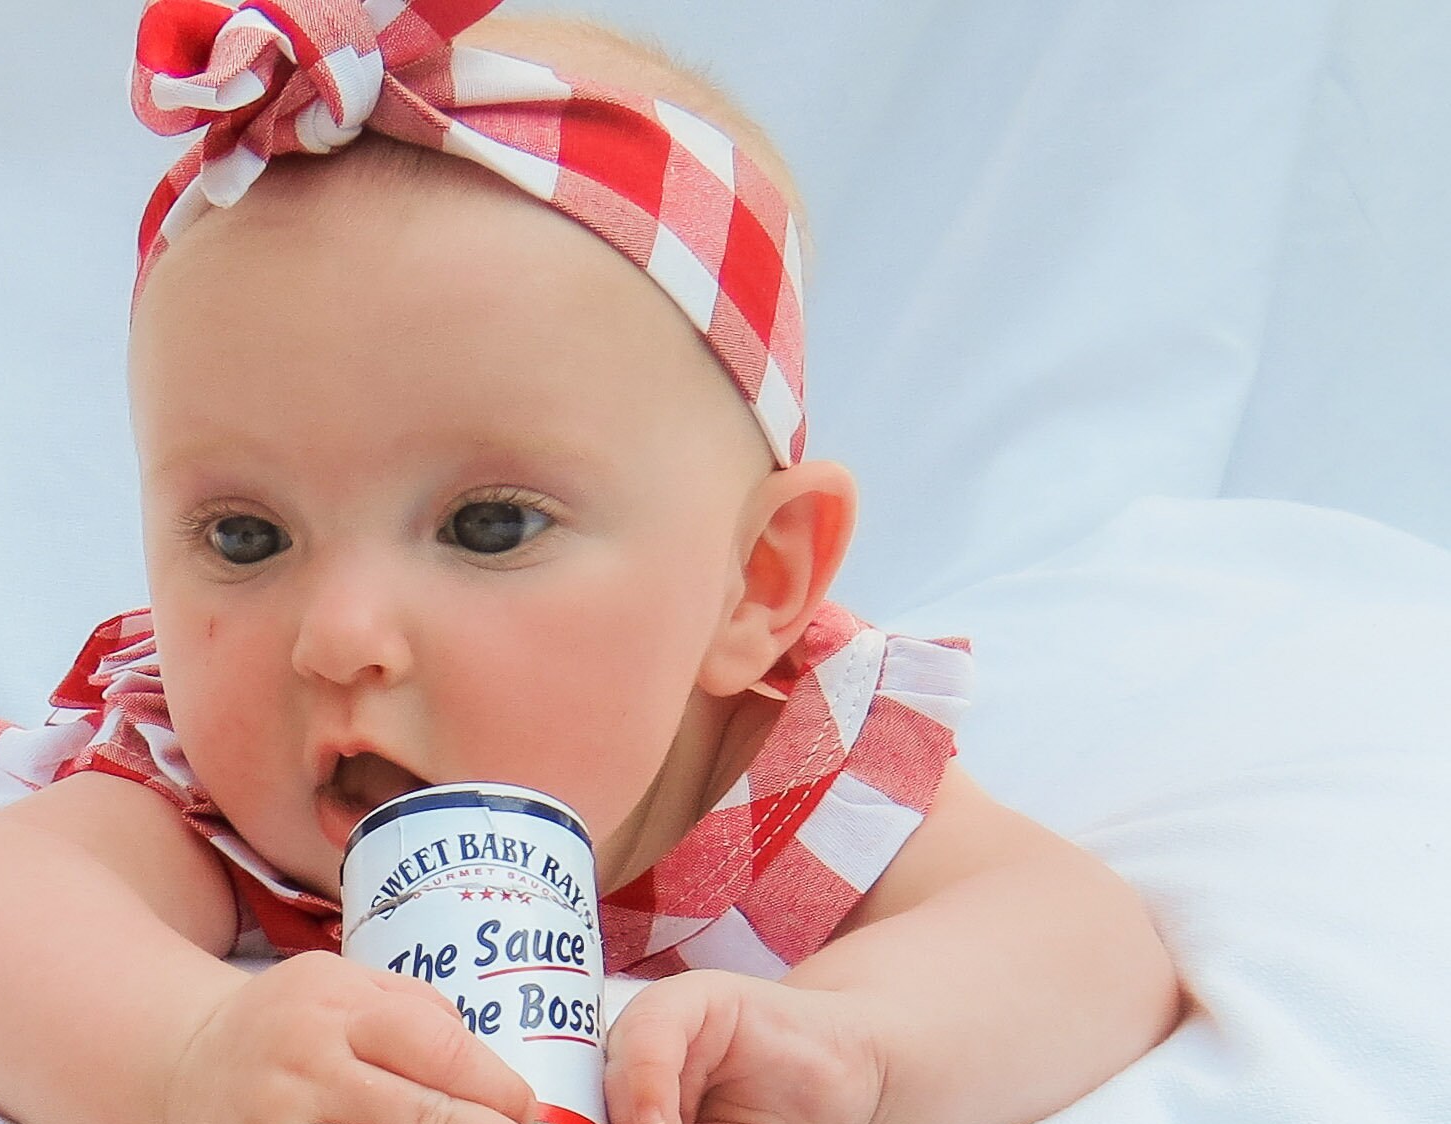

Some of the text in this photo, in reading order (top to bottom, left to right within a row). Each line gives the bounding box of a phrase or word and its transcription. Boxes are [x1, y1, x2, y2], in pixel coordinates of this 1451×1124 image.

[370, 838, 450, 921] SWEET
[457, 832, 537, 868] BABY
[474, 919, 585, 968] Sauce
[456, 983, 600, 1039] he Boss!
